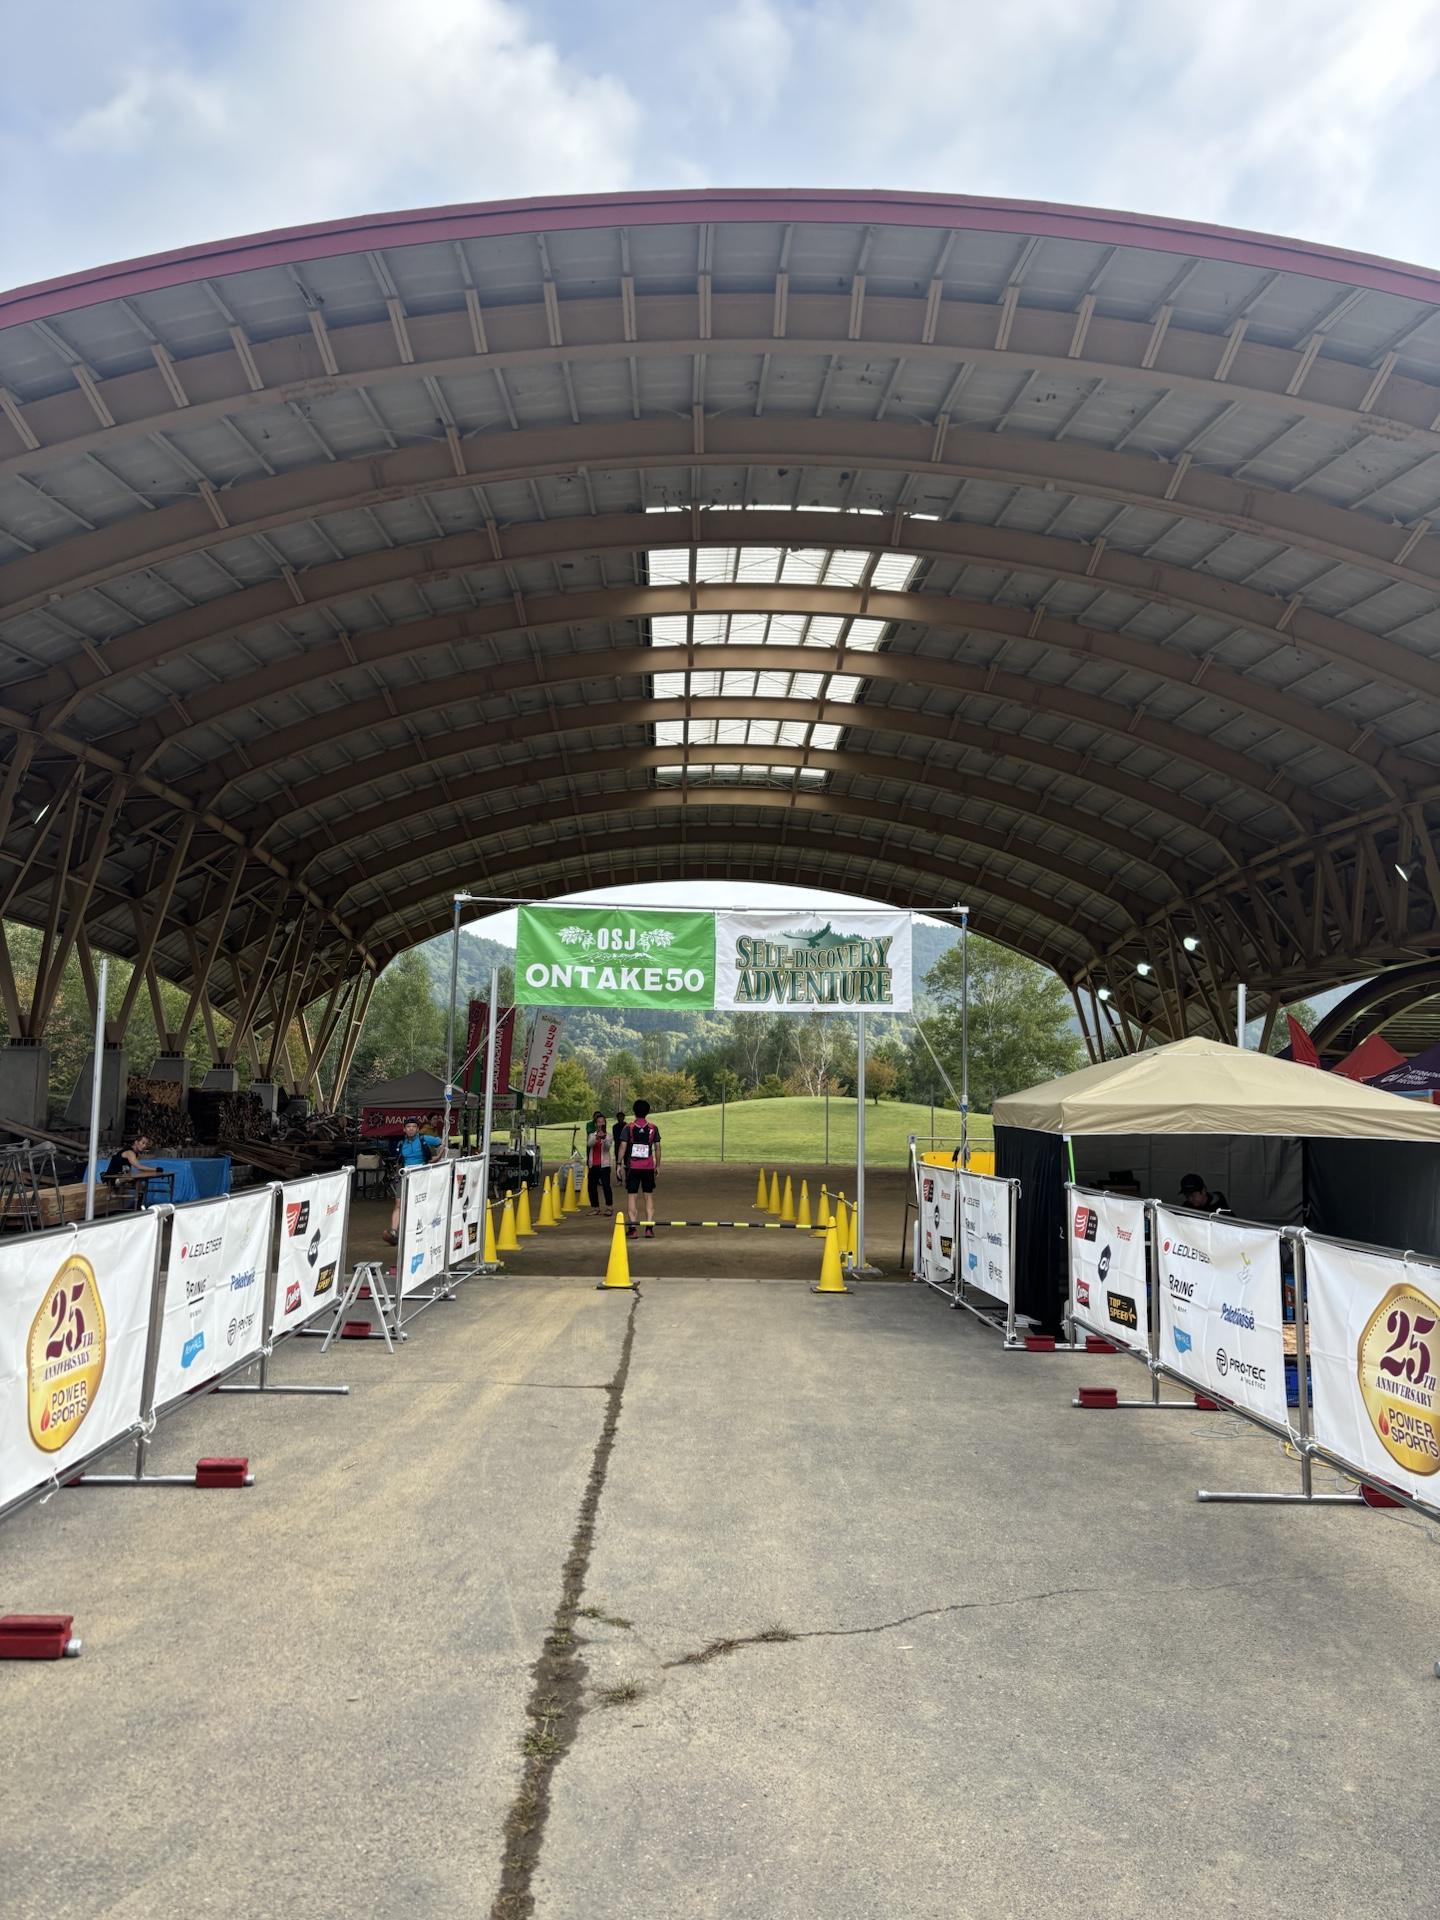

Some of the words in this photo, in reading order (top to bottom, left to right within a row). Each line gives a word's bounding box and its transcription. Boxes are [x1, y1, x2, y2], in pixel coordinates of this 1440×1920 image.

[597, 928, 636, 950] OSJ
[736, 935, 893, 969] SELF-DISCOVERY
[525, 963, 705, 992] ONTAKE50
[734, 969, 893, 1004] ADVENTURE
[1169, 1274, 1194, 1297] BRING
[1109, 1297, 1120, 1307] TOP
[1110, 1307, 1130, 1320] SPEED
[43, 1351, 90, 1381] ANNIVERSARY
[52, 1381, 87, 1410] POWER
[1375, 1376, 1433, 1408] ANNIVERSARY
[50, 1398, 87, 1428] SPORTS
[1388, 1408, 1434, 1439] POWER
[1391, 1428, 1440, 1458] SPORTS
